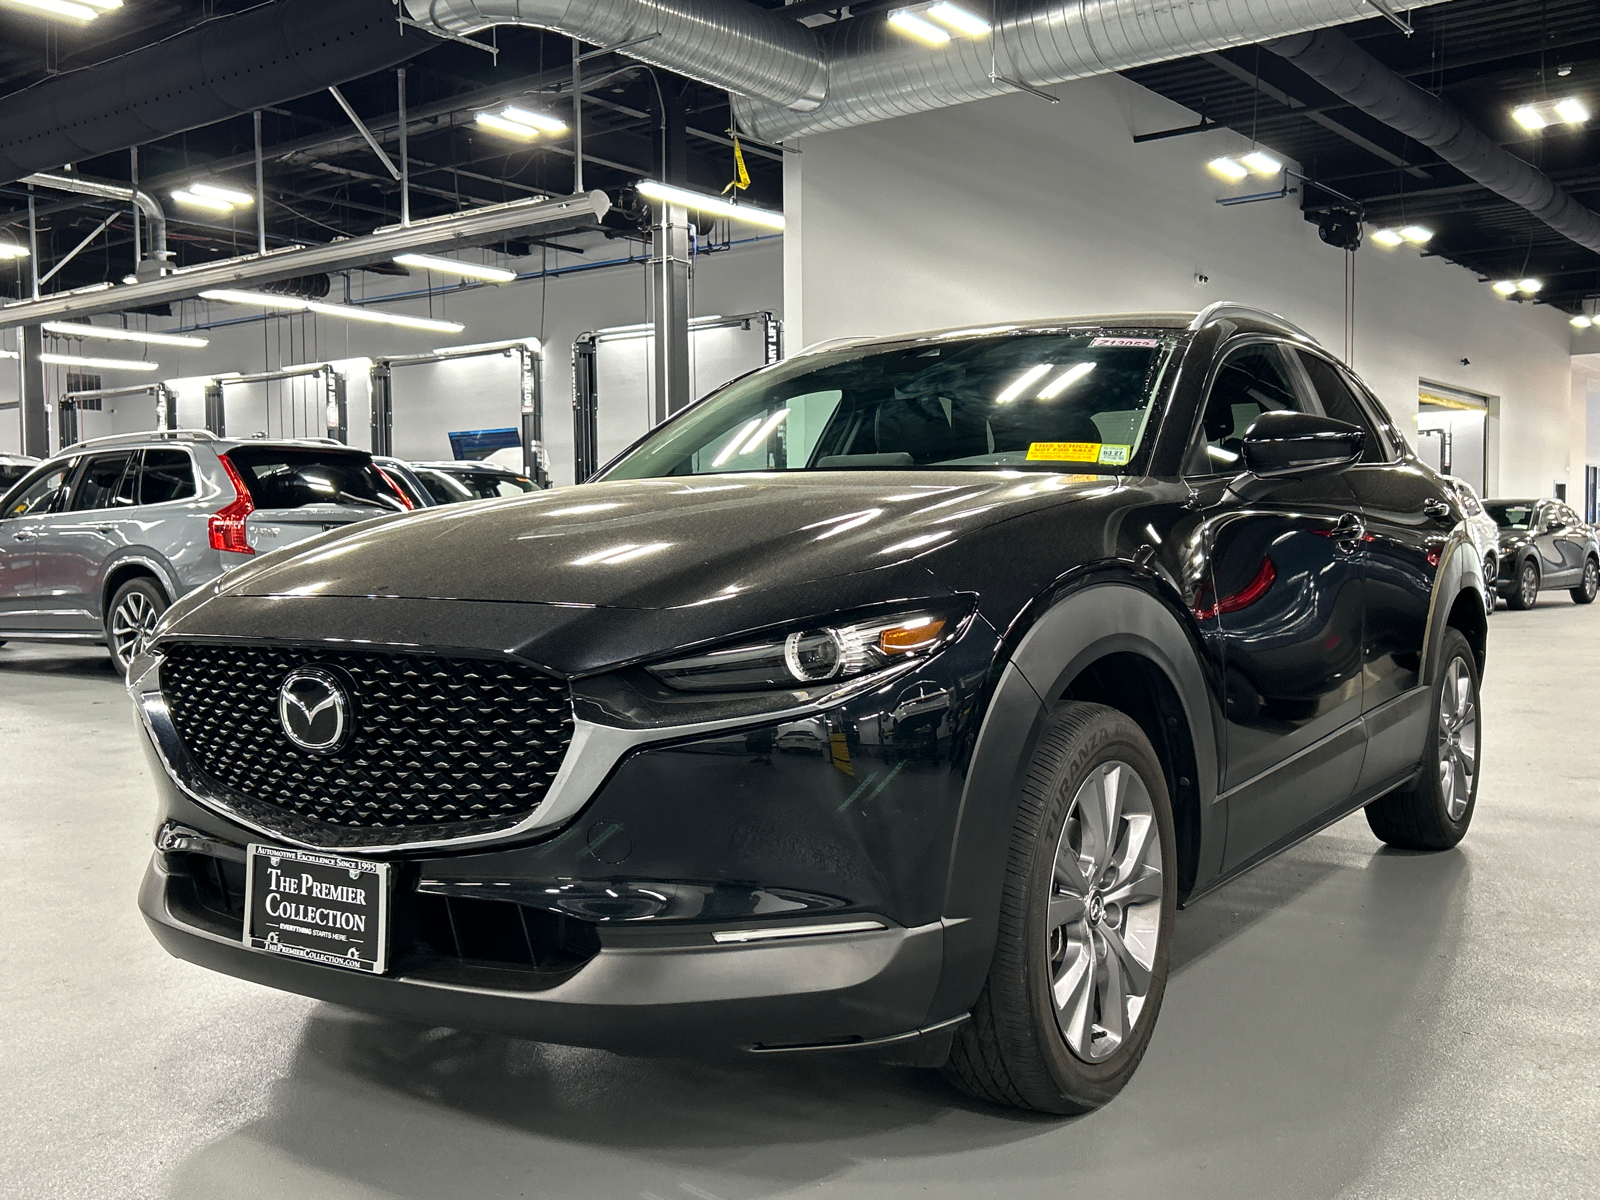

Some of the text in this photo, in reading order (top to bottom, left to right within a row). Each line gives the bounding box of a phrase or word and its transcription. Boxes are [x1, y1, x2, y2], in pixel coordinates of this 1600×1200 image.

[768, 320, 777, 342] LIFT
[328, 373, 336, 390] LIFT
[523, 351, 532, 407] ROTARY LIFT
[1045, 727, 1109, 843] TURANZA
[357, 861, 376, 872] 1995
[267, 868, 367, 905] THE PREMIER
[265, 892, 367, 932] COLLECTION
[279, 923, 312, 935] EVERYTHING
[312, 929, 332, 939] STARTS
